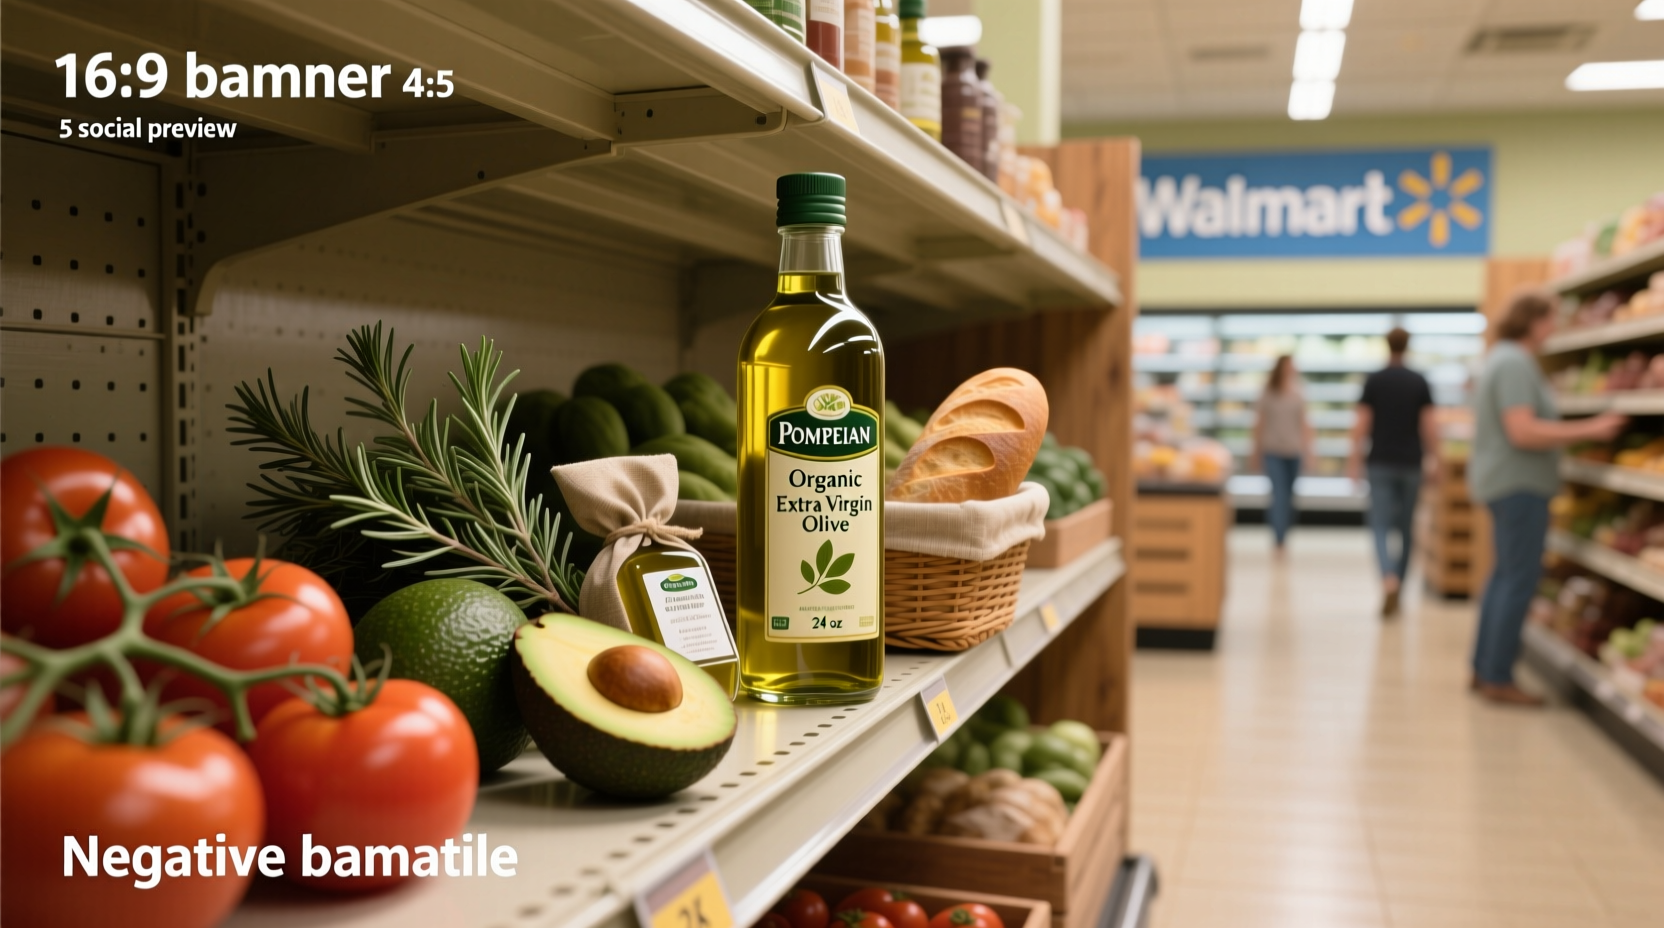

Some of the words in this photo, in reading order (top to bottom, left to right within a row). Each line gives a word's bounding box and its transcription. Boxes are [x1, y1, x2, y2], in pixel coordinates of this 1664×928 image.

[1136, 170, 1394, 239] Walmart
[778, 421, 871, 446] POMPEIAN
[788, 469, 863, 493] Organic
[776, 495, 822, 513] Extra
[825, 494, 872, 517] Virgin
[801, 514, 850, 533] Olive
[811, 615, 827, 630] 24
[829, 619, 843, 630] oz
